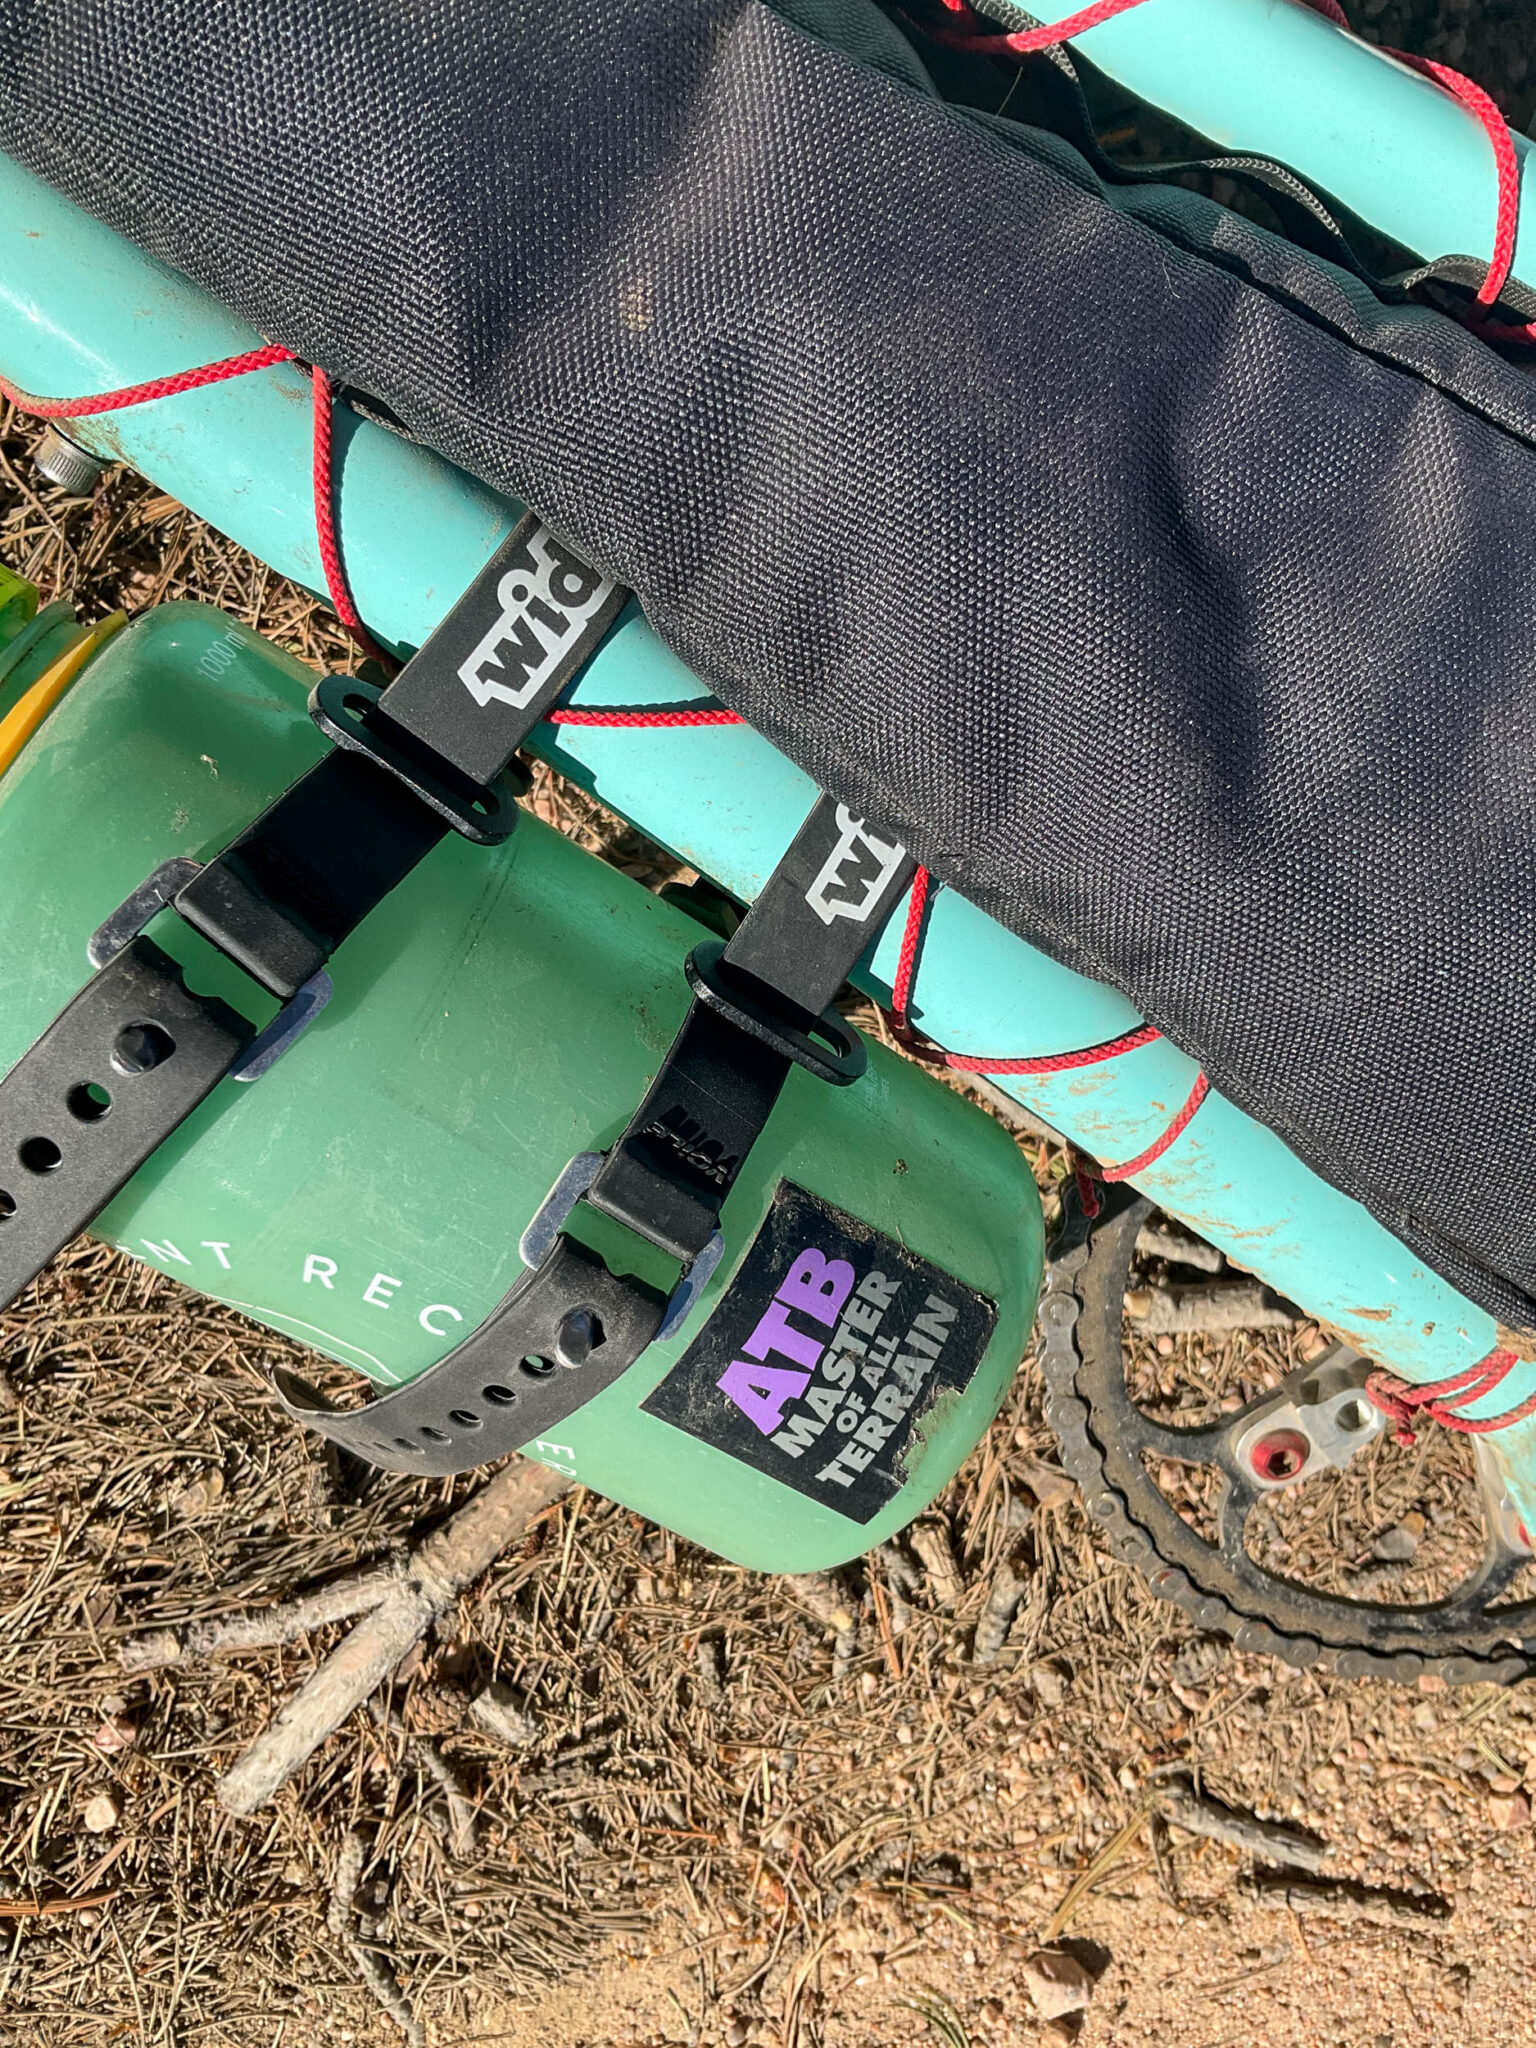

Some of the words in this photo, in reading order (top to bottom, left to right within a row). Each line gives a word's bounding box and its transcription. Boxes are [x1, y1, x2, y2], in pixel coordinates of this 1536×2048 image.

[195, 641, 238, 682] 1000
[224, 626, 248, 650] ml
[468, 531, 606, 698] wid
[303, 1254, 462, 1336] REC
[716, 1247, 855, 1436] ATB
[770, 1271, 902, 1458] MASTER
[815, 1294, 959, 1487] TERRAIN
[836, 1392, 867, 1433] OF
[860, 1335, 900, 1391] ALL
